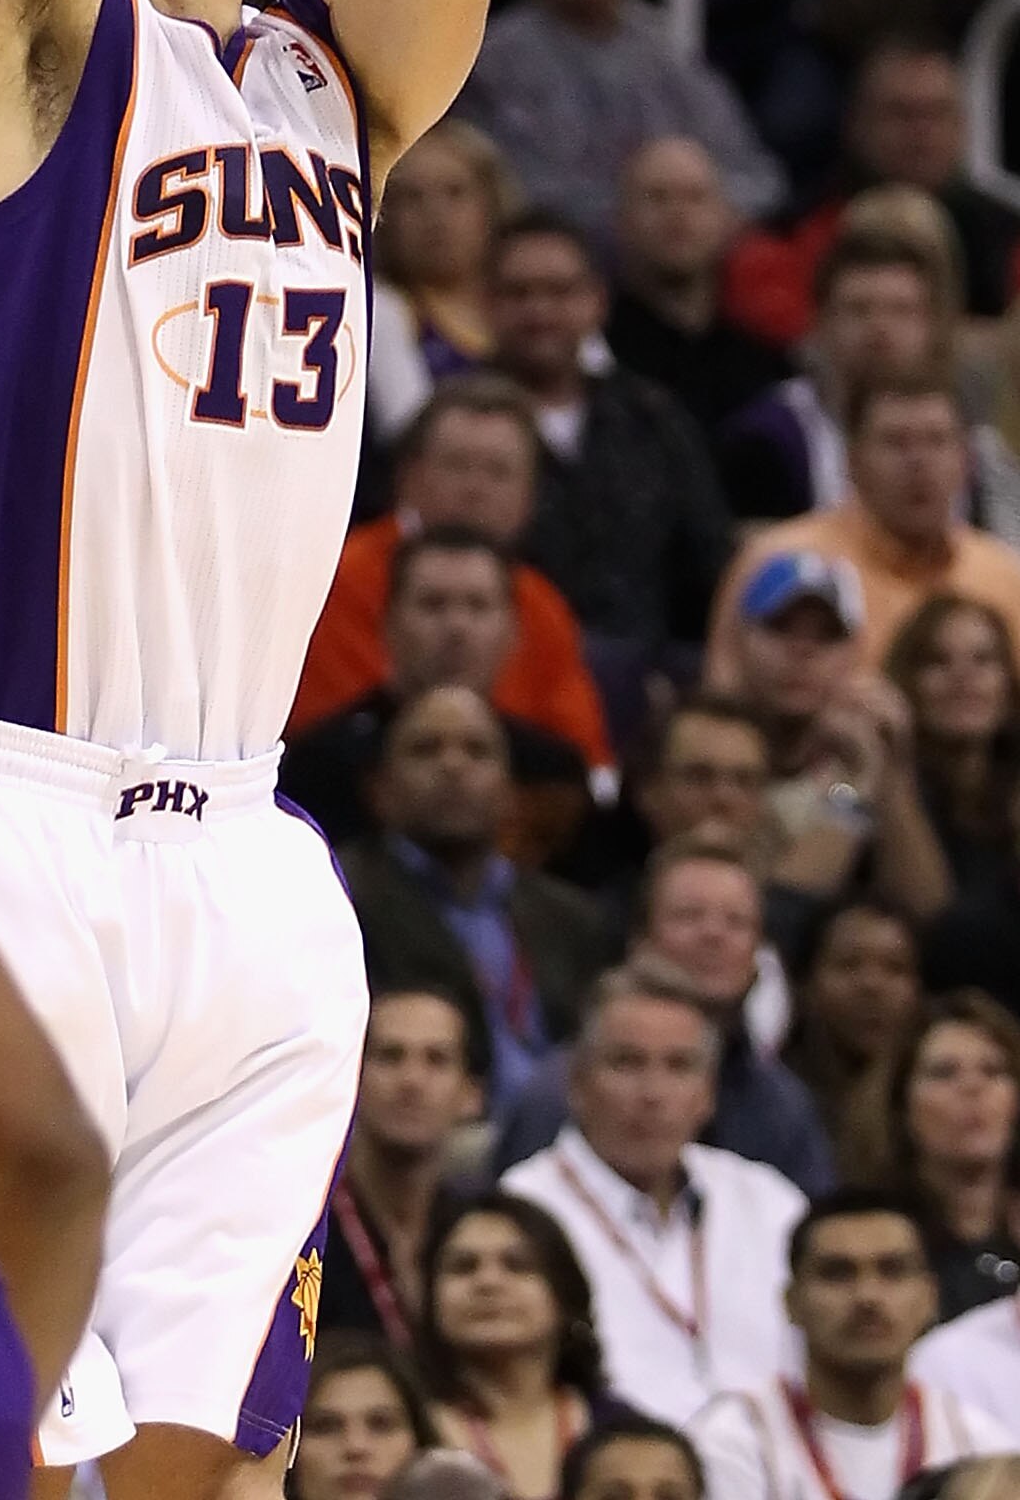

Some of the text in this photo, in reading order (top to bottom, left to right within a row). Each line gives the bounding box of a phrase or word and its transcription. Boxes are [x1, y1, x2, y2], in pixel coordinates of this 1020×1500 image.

[128, 143, 362, 269] SUNS
[190, 279, 347, 432] 13
[114, 779, 209, 822] PHX
